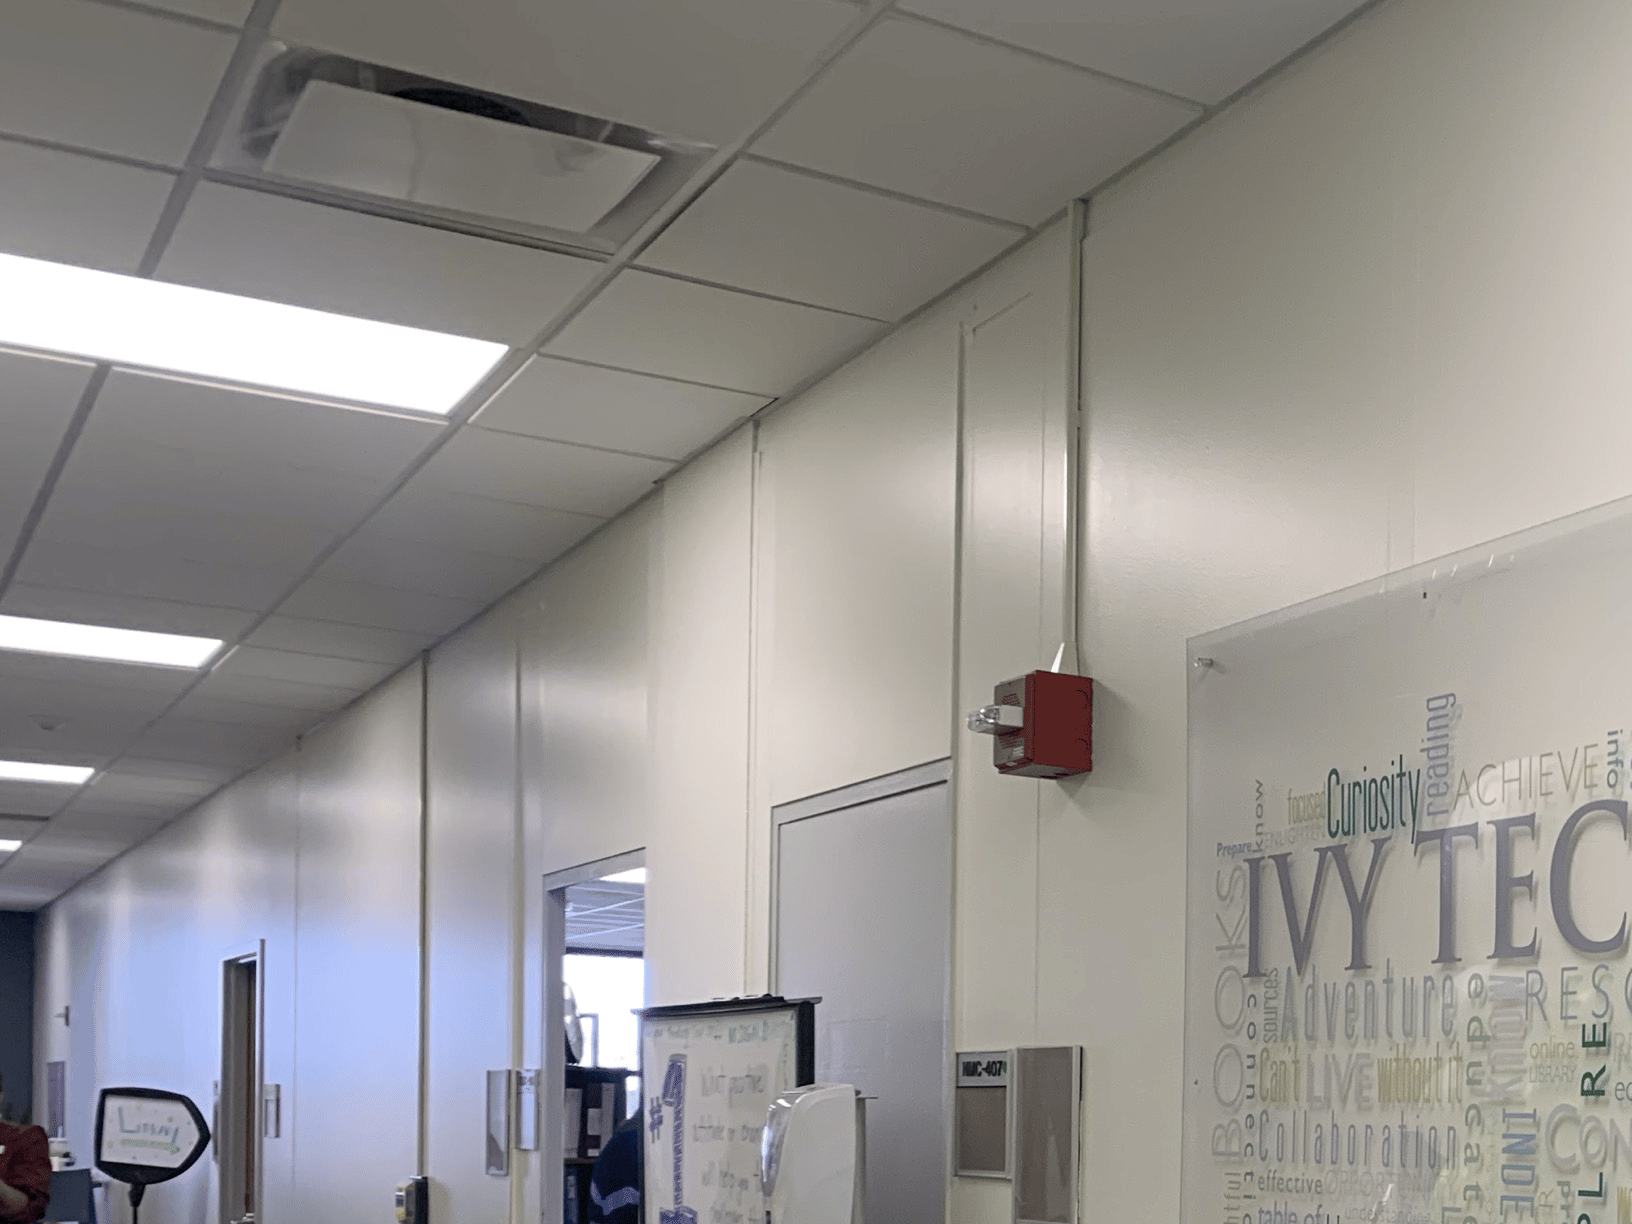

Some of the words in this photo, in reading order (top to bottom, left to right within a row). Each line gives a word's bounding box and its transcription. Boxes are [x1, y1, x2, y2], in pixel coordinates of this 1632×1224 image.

[1420, 693, 1456, 818] reading
[1453, 743, 1599, 811] ACHIEVE
[1607, 729, 1624, 789] info
[1251, 779, 1264, 853] know
[1327, 754, 1421, 844] Curiosity
[1243, 837, 1392, 978] IVY
[1211, 864, 1248, 1158] BOOKS
[1281, 957, 1454, 1042] Adventure
[1259, 1046, 1300, 1103] Can't
[1306, 1053, 1372, 1104] LIVE
[1377, 1041, 1442, 1103] without
[1258, 1109, 1457, 1170] Collaboration
[1257, 1169, 1322, 1195] effective
